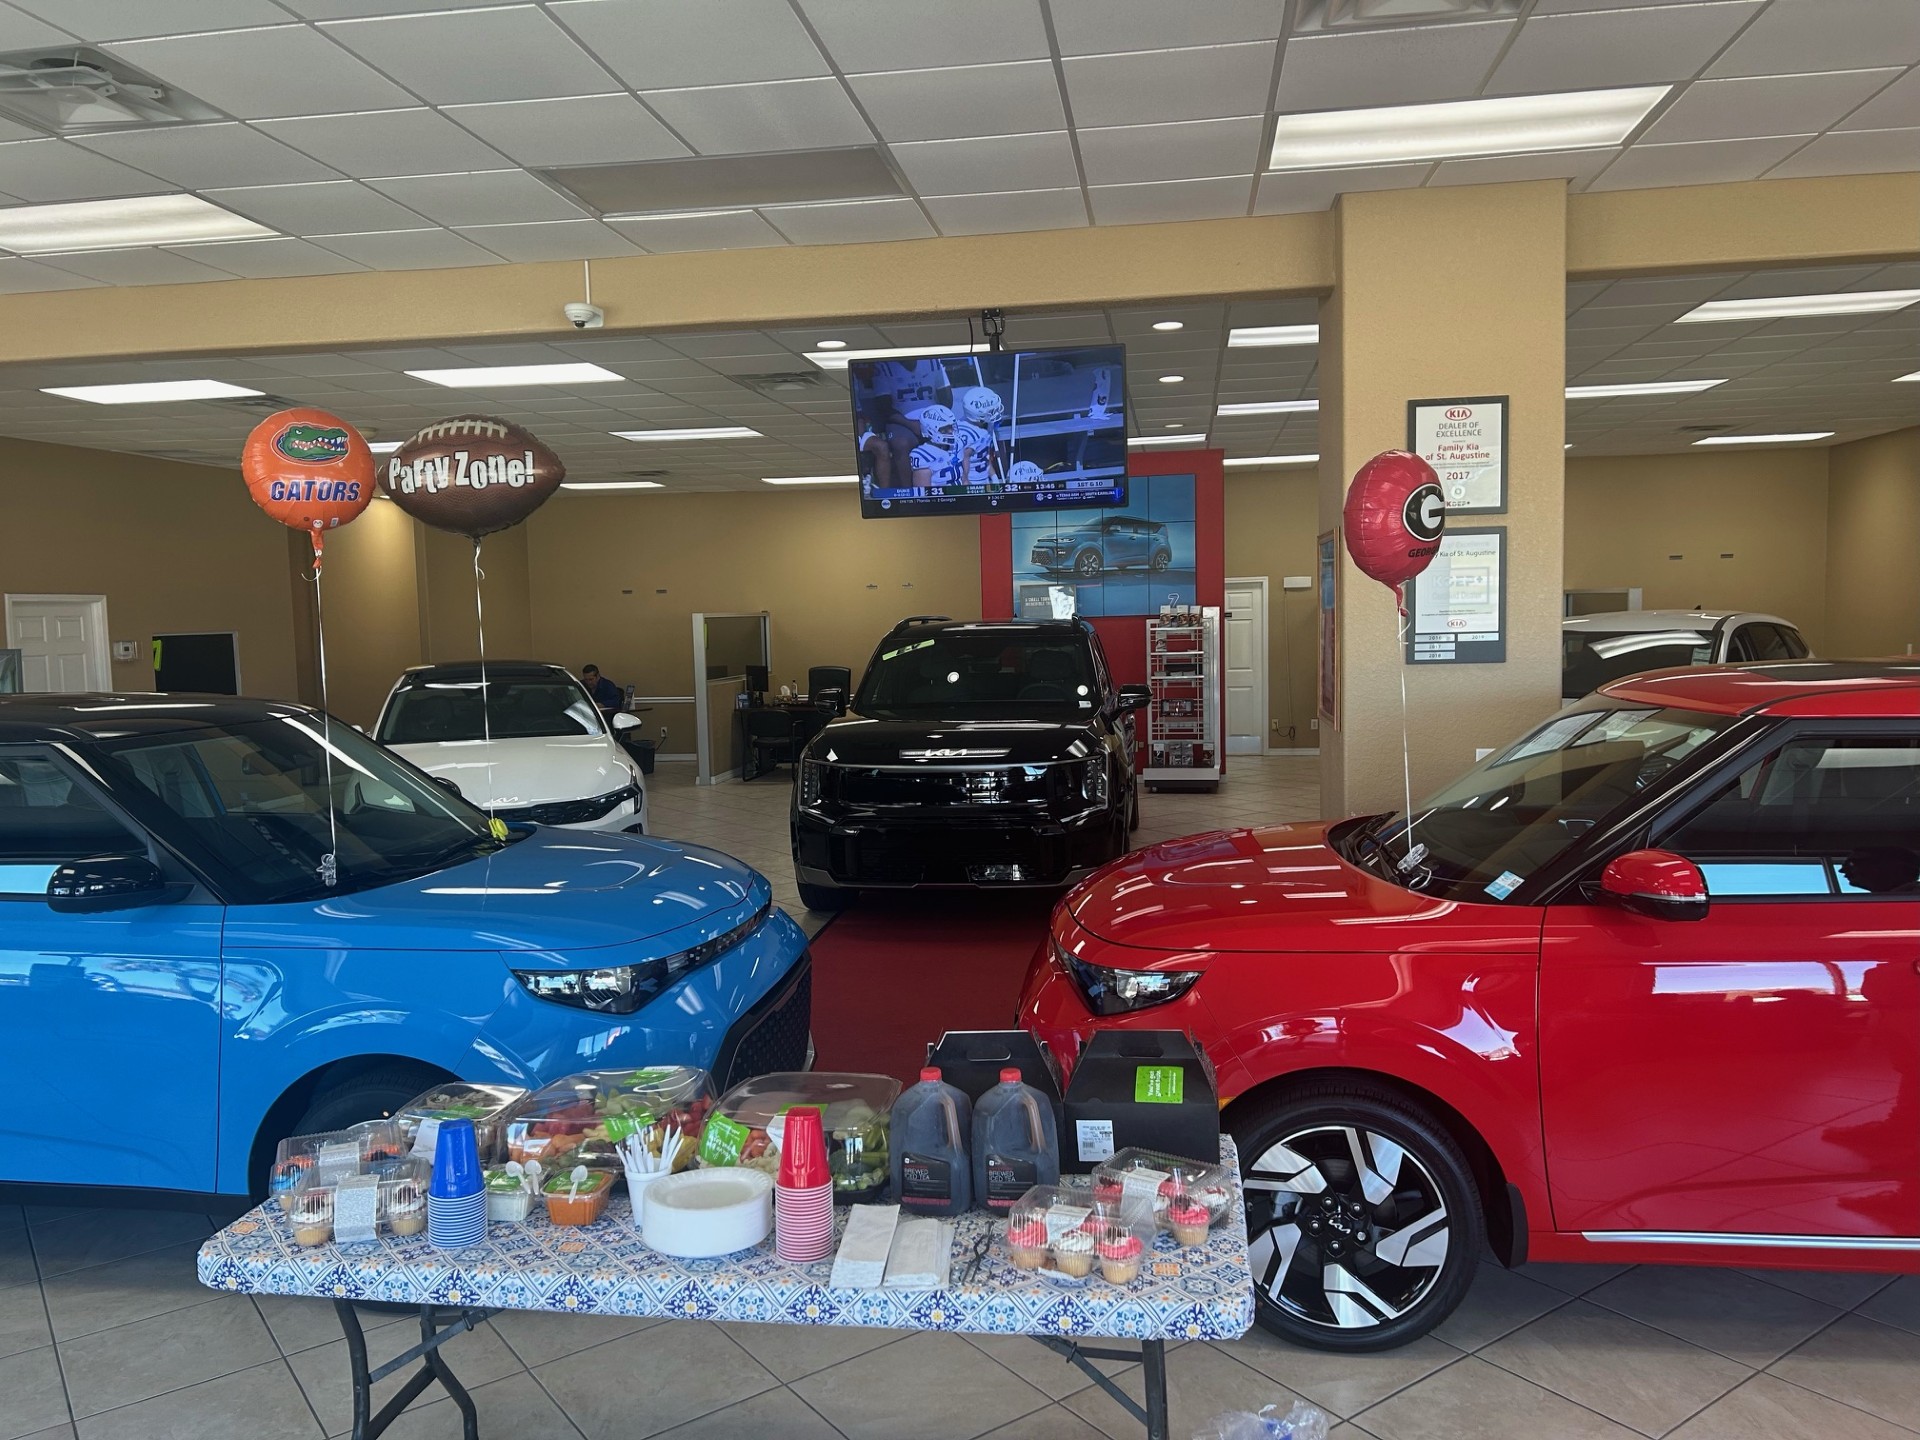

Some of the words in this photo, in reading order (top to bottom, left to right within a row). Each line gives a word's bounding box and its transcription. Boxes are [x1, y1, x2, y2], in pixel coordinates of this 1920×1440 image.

[1449, 410, 1468, 418] KIA
[1438, 422, 1468, 430] DEALER
[1468, 421, 1480, 429] OF
[1435, 429, 1482, 438] EXCELLENCE
[1438, 444, 1464, 452] Family
[1436, 452, 1447, 460] St.
[1449, 451, 1491, 461] Augustine
[388, 455, 449, 495] Party
[455, 450, 535, 490] Zone!
[1446, 471, 1471, 480] 2017
[269, 479, 361, 502] GATORS
[931, 487, 944, 495] 31
[1004, 484, 1018, 492] 32
[988, 1170, 1014, 1178] BREWED
